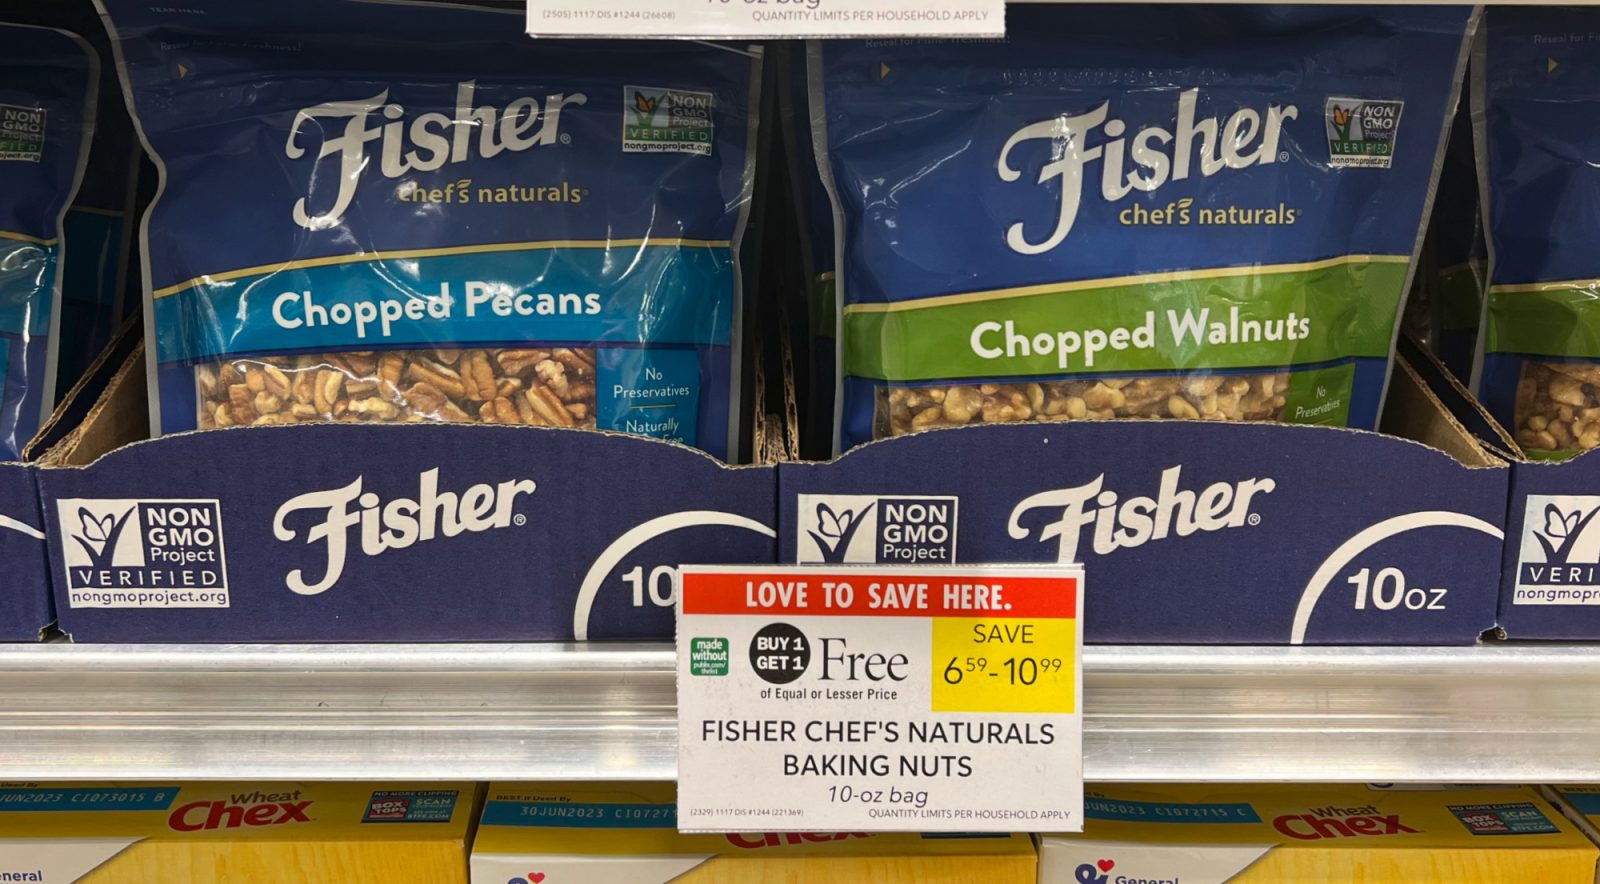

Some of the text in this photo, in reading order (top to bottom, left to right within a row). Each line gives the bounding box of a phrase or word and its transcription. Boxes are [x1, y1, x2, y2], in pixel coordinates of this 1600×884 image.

[543, 10, 571, 20] (2505)
[574, 10, 595, 20] 1117
[597, 11, 612, 20] DIS
[613, 11, 641, 20] #1244
[752, 11, 989, 22] QUANTITY LIMITS PER HOUSEHOLD APPLY
[672, 95, 707, 109] NON
[5, 110, 41, 124] NON
[673, 108, 707, 118] GMO
[1363, 105, 1395, 117] NON
[3, 120, 40, 132] GMO
[672, 117, 709, 129] Project
[1363, 117, 1393, 129] GMO
[630, 128, 708, 141] VERIFIED
[285, 79, 588, 232] Fisher
[624, 142, 711, 154] nongmoproject.org
[1334, 142, 1388, 154] VERIFIED
[996, 87, 1297, 255] Fisher
[479, 181, 582, 204] naturals
[1118, 198, 1295, 225] chef's naturals
[272, 281, 601, 338] Chopped Pecans
[969, 306, 1310, 369] Chopped Walnuts
[645, 367, 663, 381] No
[613, 384, 689, 399] Preservatives
[1315, 385, 1326, 399] No
[1294, 399, 1341, 419] Preservatives
[626, 417, 679, 435] Naturally
[147, 508, 211, 526] NON
[885, 504, 947, 523] NON
[1006, 464, 1276, 564] Fisher
[148, 527, 215, 547] GMO
[273, 466, 537, 596] Fisher
[883, 524, 949, 544] GMO
[150, 547, 216, 566] Project
[884, 544, 946, 563] Project
[79, 570, 217, 585] VERIFIED
[72, 590, 227, 605] nongmoproject.org
[745, 581, 1013, 611] LOVE TO SAVE HERE.
[1517, 589, 1600, 603] nongmopr
[973, 624, 1034, 644] SAVE
[697, 638, 723, 650] made
[756, 637, 805, 652] BUY 1
[692, 649, 728, 661] without
[817, 637, 909, 682] Free
[756, 656, 805, 671] GET 1
[760, 688, 898, 702] of Equal or Lesser Price
[702, 720, 1055, 745] FISHER CHEF'S NATURALS
[783, 754, 973, 778] BAKING NUTS
[153, 792, 166, 802] B
[230, 790, 303, 805] Wheat
[828, 785, 929, 809] 10-oz bag
[372, 801, 403, 809] BOX
[520, 806, 605, 818] 30JUN2023
[690, 808, 804, 817] (2329) 1117 DIS #1244 (221369)
[1236, 807, 1246, 816] C
[1309, 804, 1382, 818] Wheat
[168, 800, 315, 832] Chex
[868, 808, 1071, 820] QUANTITY LIMITS PER HOUSEHOLD APPLY
[1461, 814, 1494, 823] BOX
[1272, 814, 1419, 841] Chex
[0, 870, 43, 882] neral
